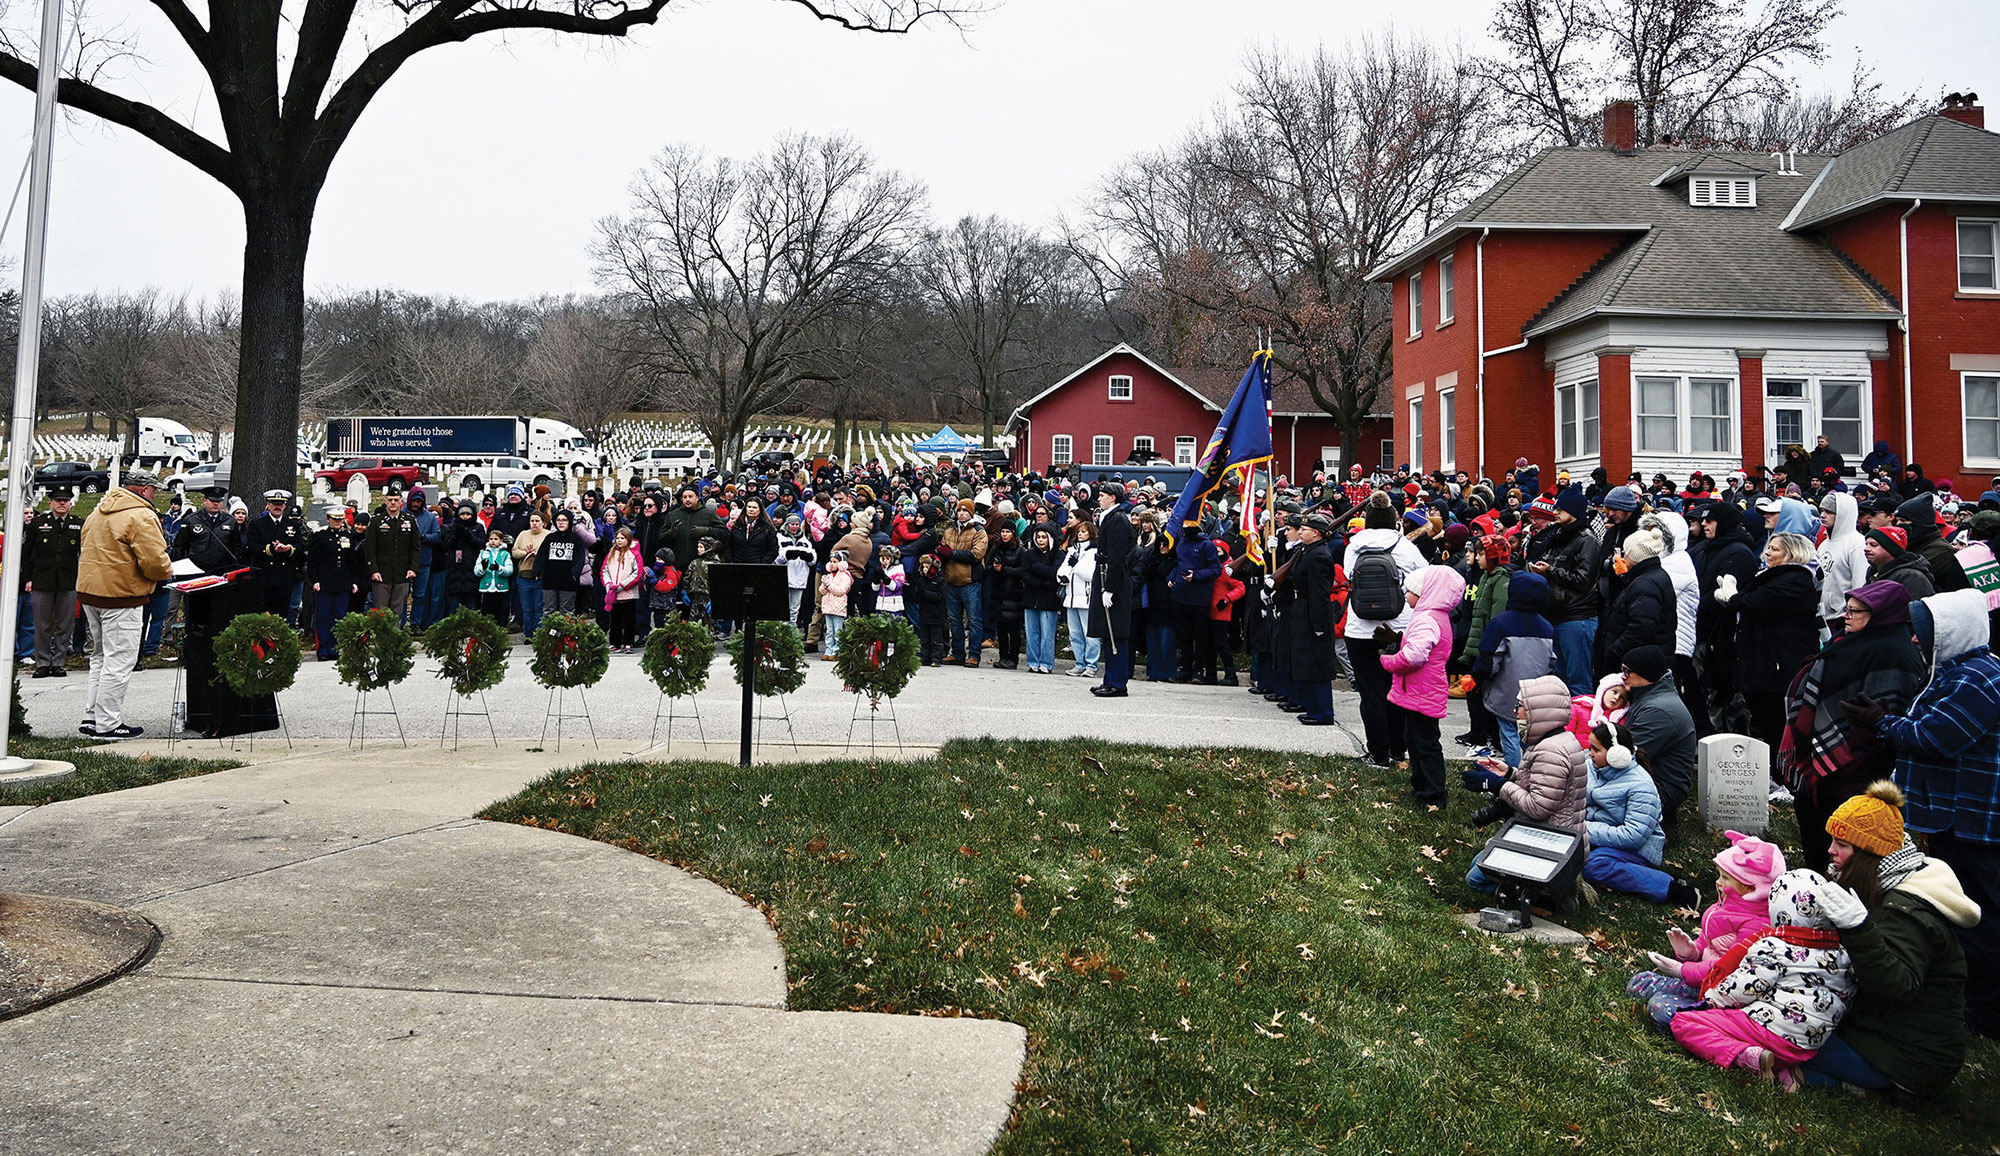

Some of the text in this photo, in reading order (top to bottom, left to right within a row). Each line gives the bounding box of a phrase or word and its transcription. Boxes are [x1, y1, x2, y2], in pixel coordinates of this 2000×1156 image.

[370, 427, 453, 437] We're grateful to those
[370, 438, 432, 446] who have served.
[1718, 761, 1751, 769] GEORGE
[1830, 821, 1846, 838] KC
